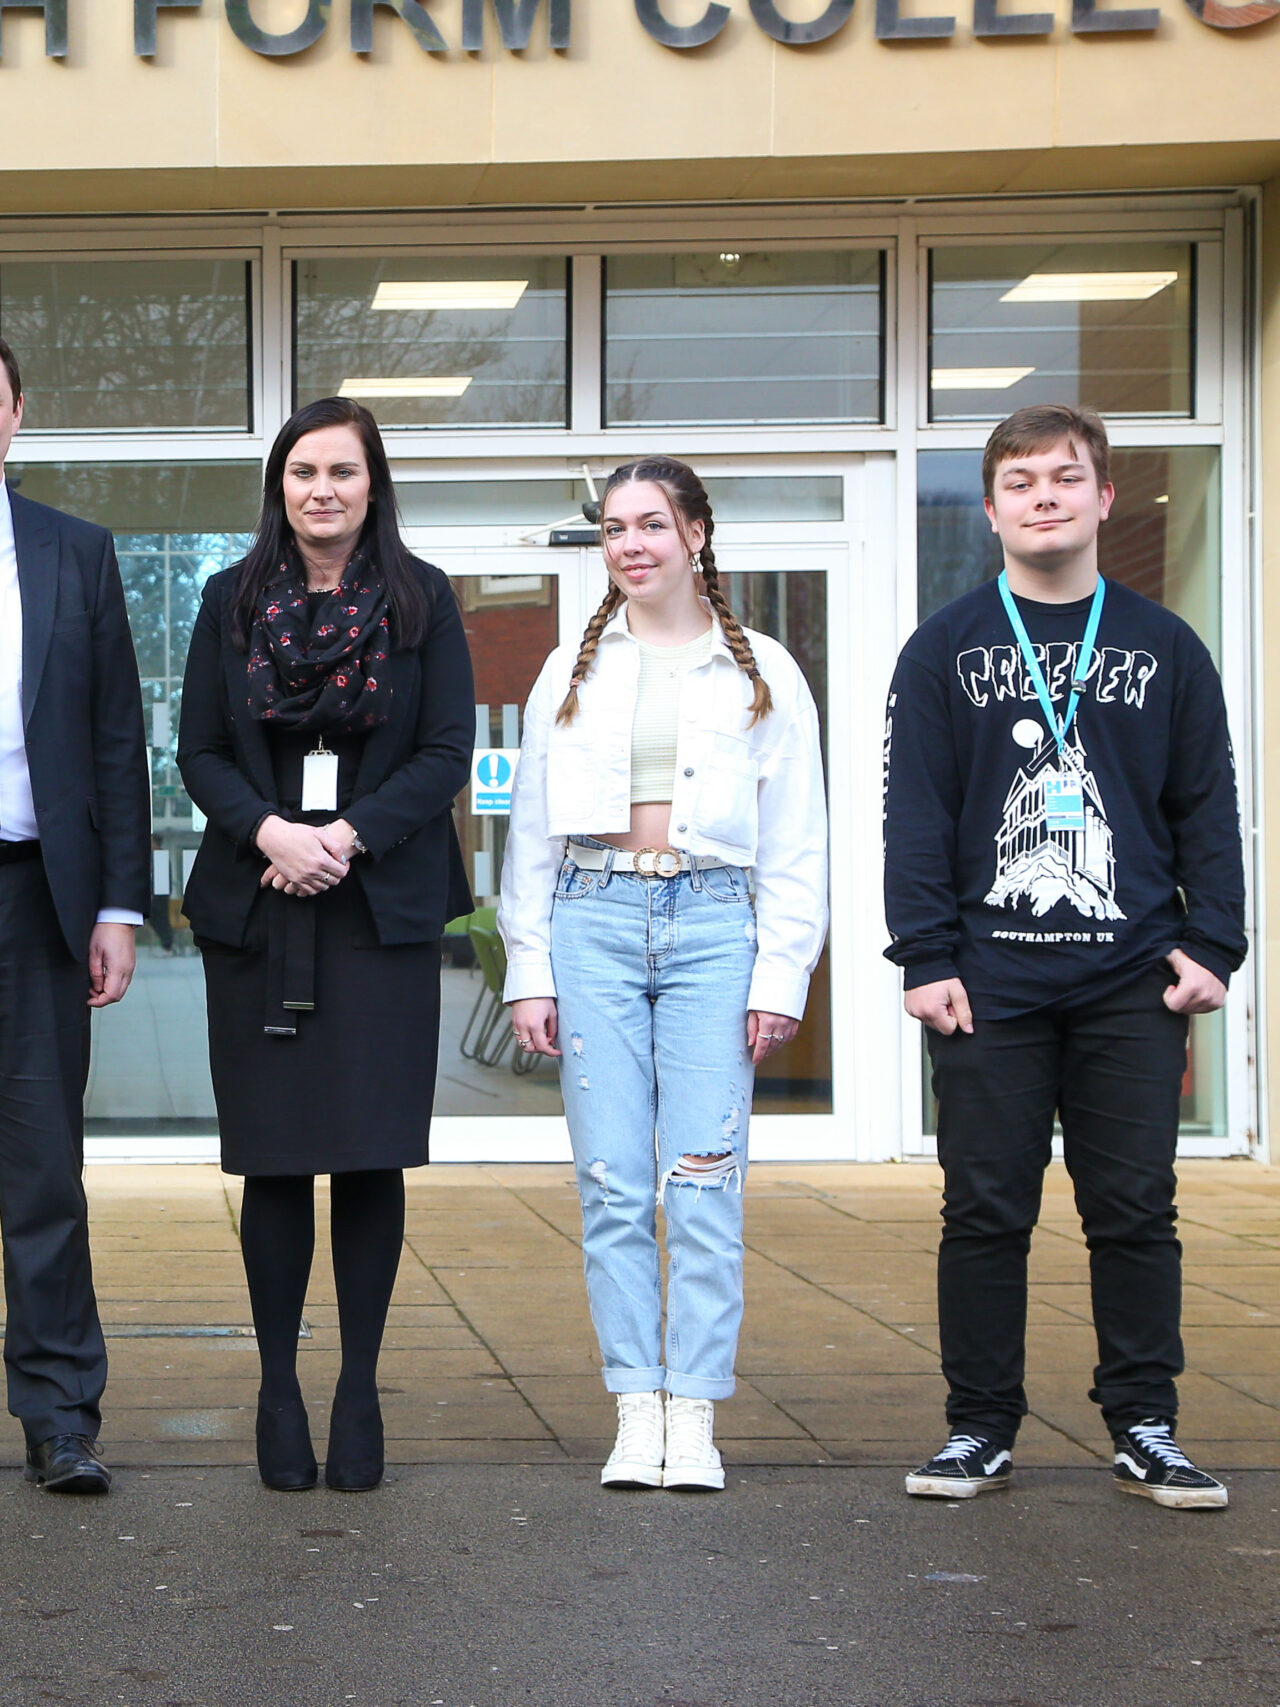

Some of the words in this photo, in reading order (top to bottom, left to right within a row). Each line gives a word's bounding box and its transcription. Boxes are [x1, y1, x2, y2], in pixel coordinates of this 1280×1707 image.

[957, 643, 1159, 709] CREEPER
[992, 930, 1092, 943] SOUTHAMPTON
[1096, 932, 1115, 943] UK
